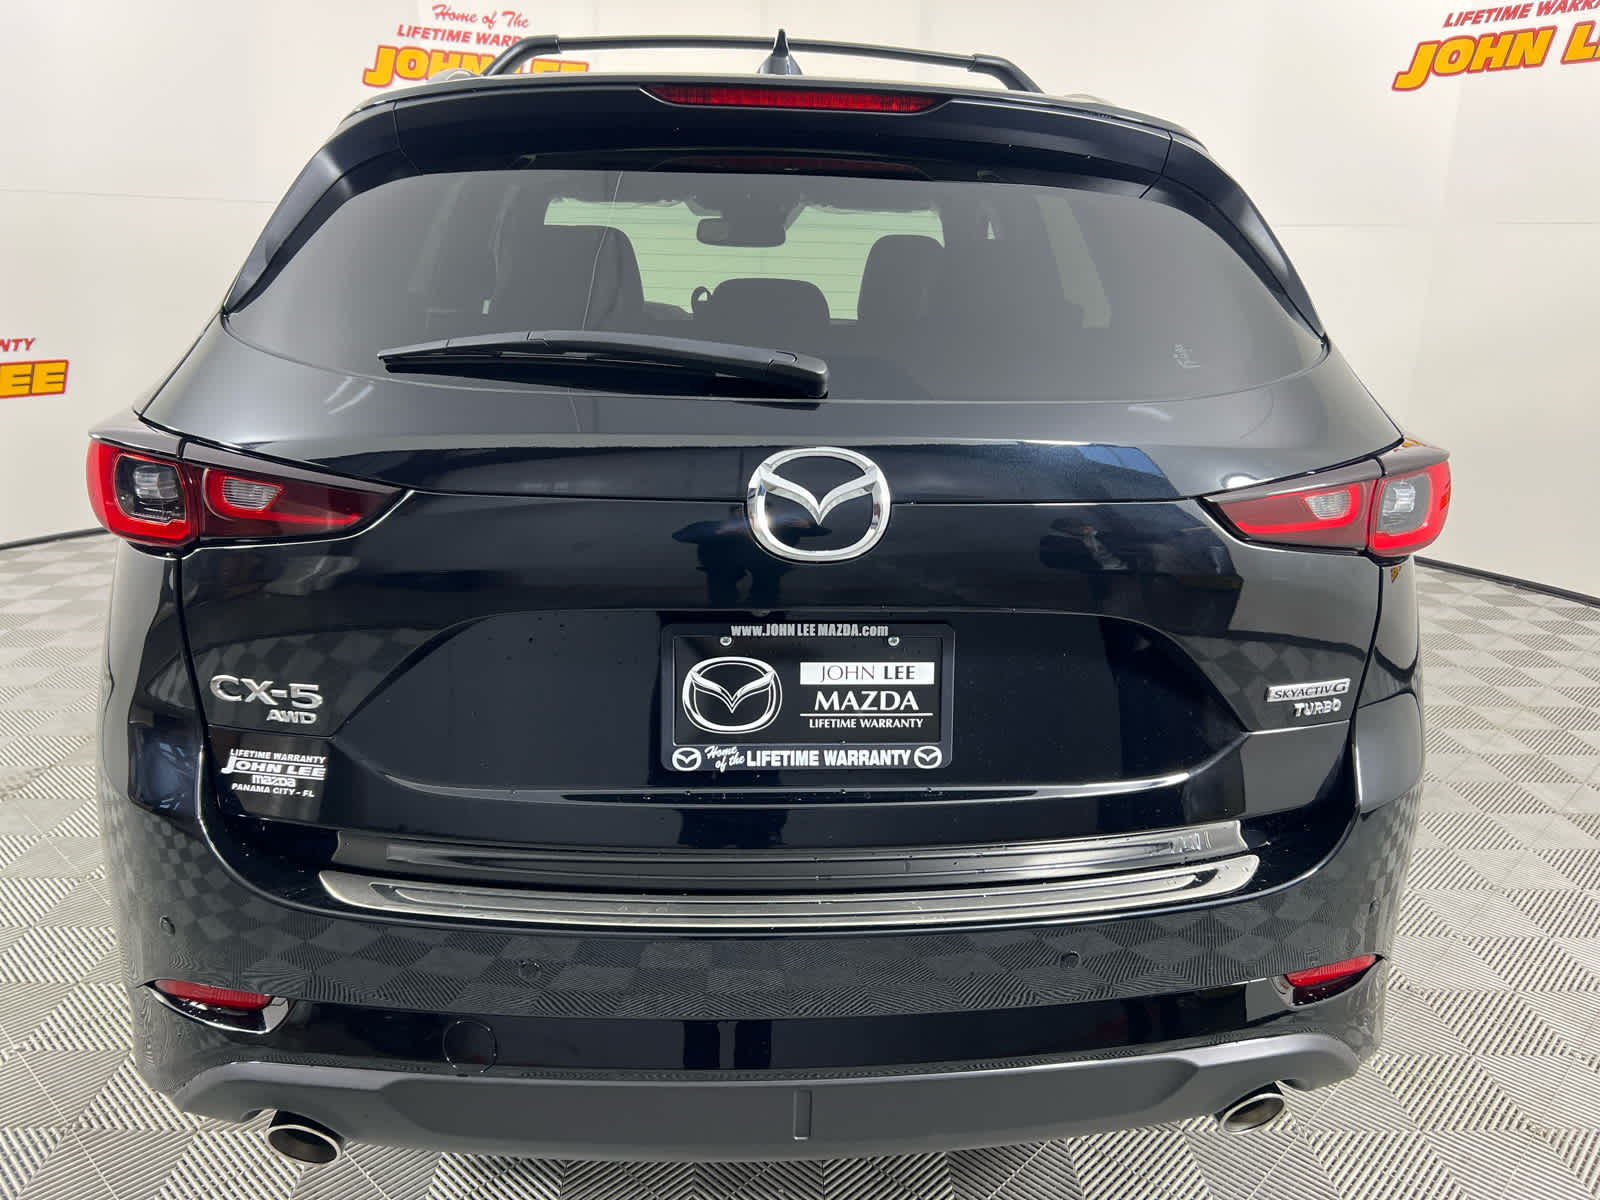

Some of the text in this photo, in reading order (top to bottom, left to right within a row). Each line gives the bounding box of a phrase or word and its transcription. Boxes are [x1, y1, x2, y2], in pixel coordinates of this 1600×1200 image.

[432, 4, 529, 29] Home of The
[1443, 3, 1533, 28] LIFETIME
[397, 24, 472, 43] LIFETIME
[1392, 25, 1557, 91] JOHN
[731, 624, 888, 637] www.JOHN LEE MAZDA.com
[820, 665, 916, 682] JOHN LEE
[210, 674, 323, 709] CX-5
[814, 690, 920, 711] MAZDA
[266, 709, 317, 724] AWD
[1294, 698, 1341, 717] TURBO
[809, 718, 924, 728] LIFETIME WARRANTY
[230, 748, 326, 764] LIFETIME WARRANTY
[704, 745, 738, 759] Home
[746, 749, 911, 767] LIFETIME WARRANTY
[221, 756, 326, 777] JOHN LEE
[715, 752, 745, 773] of the
[231, 783, 270, 794] PANAMA
[272, 787, 296, 795] CITY
[302, 789, 315, 798] FL
